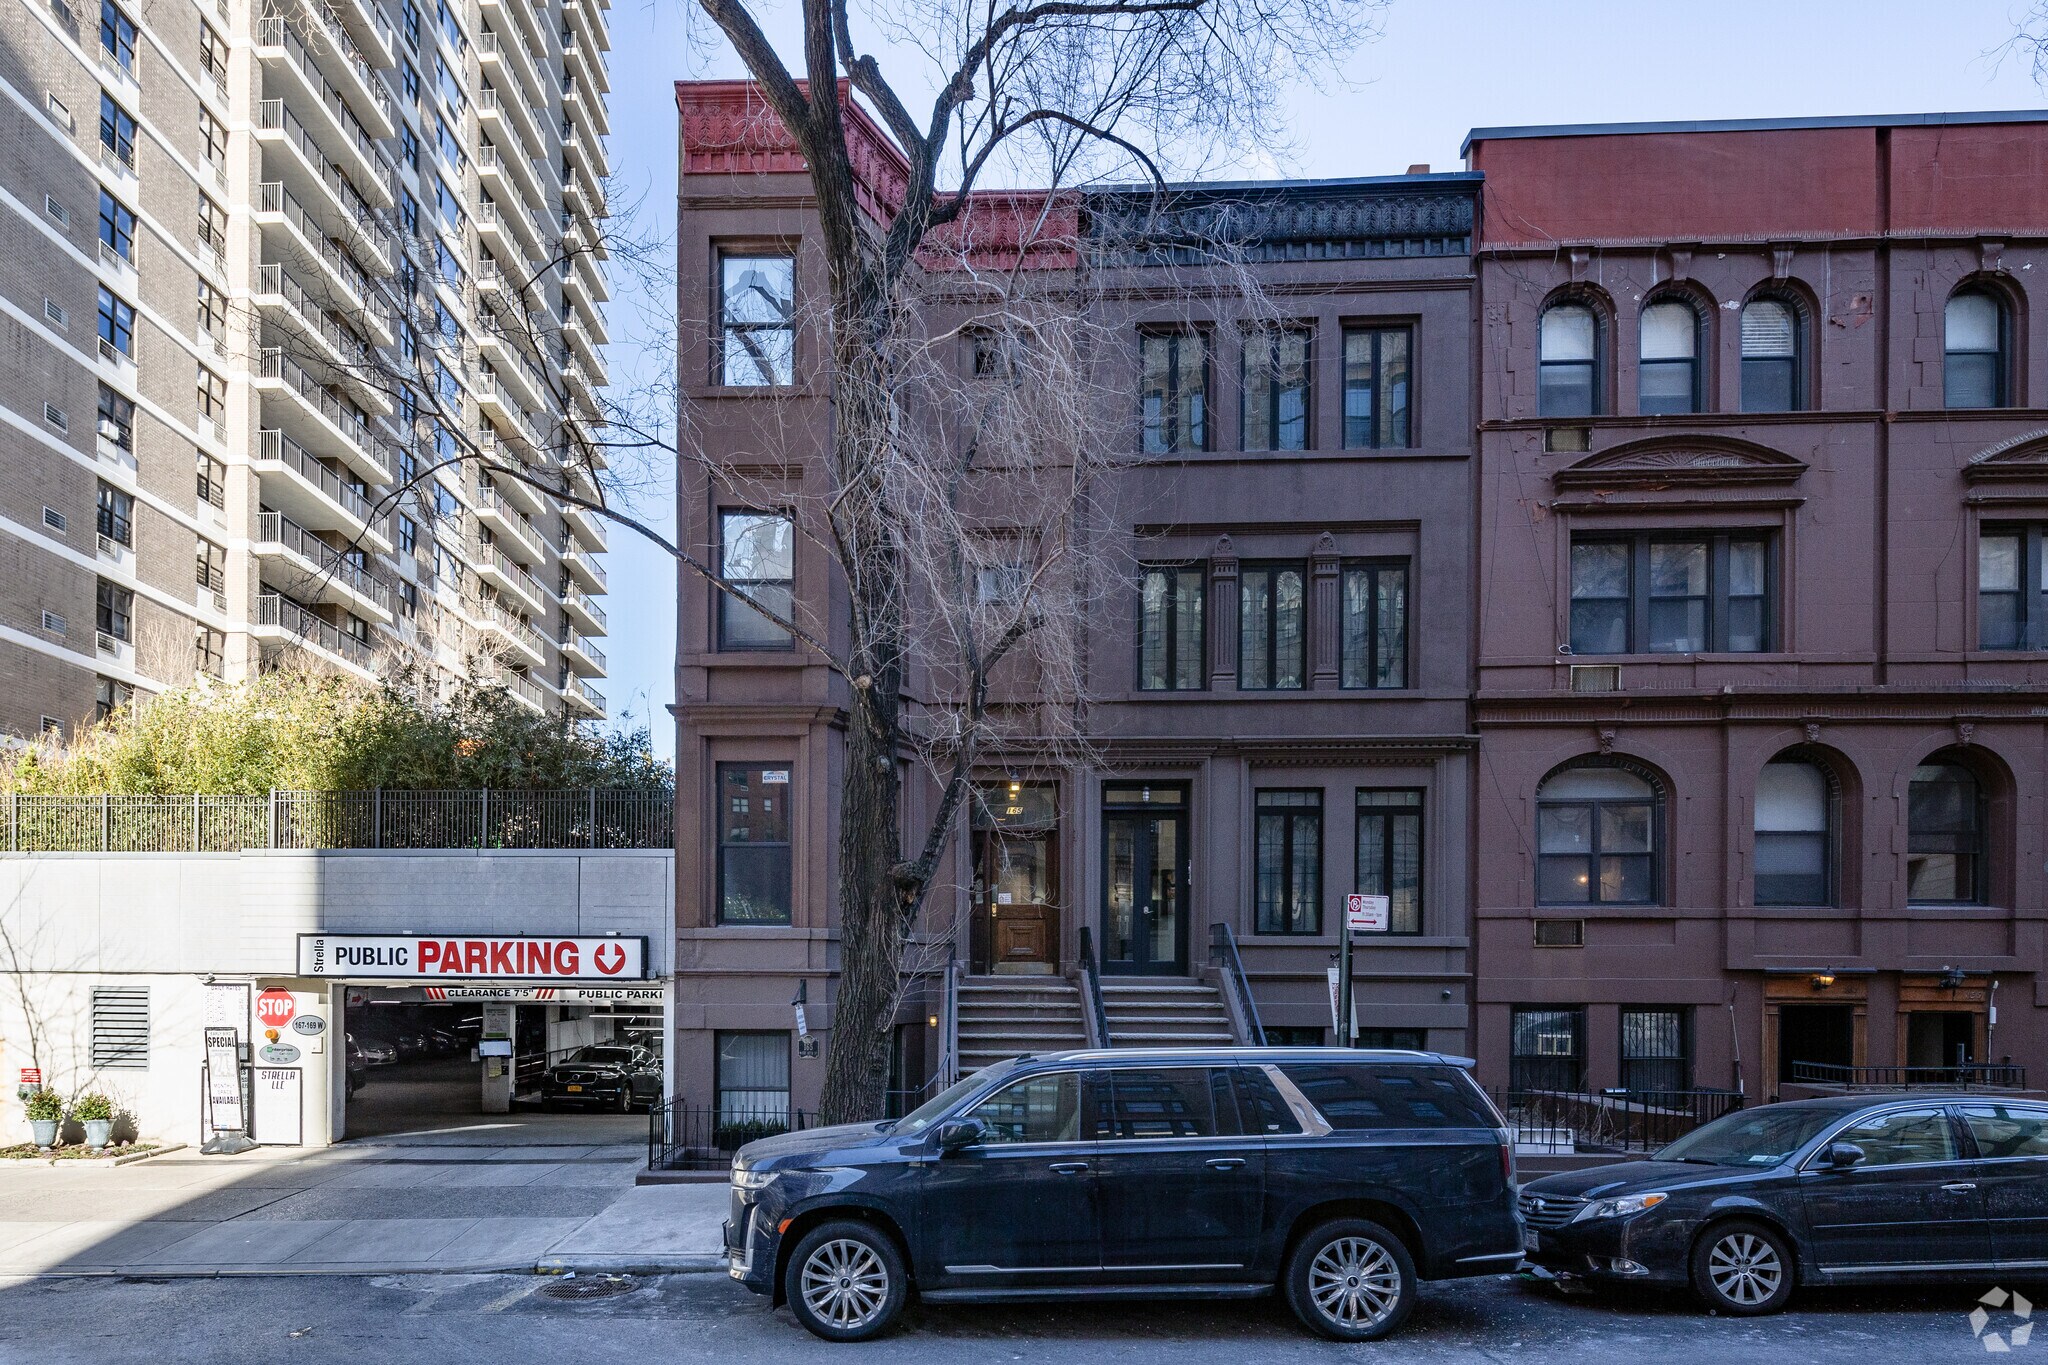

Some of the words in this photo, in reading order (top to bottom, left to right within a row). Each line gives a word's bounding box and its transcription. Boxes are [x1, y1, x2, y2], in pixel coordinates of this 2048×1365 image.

[313, 939, 325, 973] Strella
[335, 947, 408, 966] PUBLIC
[417, 941, 580, 975] PARKING
[447, 989, 511, 997] CLEARANCE
[513, 989, 534, 997] 7'5"
[578, 990, 623, 999] PUBLIC
[259, 998, 293, 1016] STOP
[208, 1037, 236, 1047] SPECIAL
[261, 1071, 295, 1080] STRELLA
[271, 1081, 285, 1090] LLC
[213, 1096, 240, 1104] AVAILABLE
